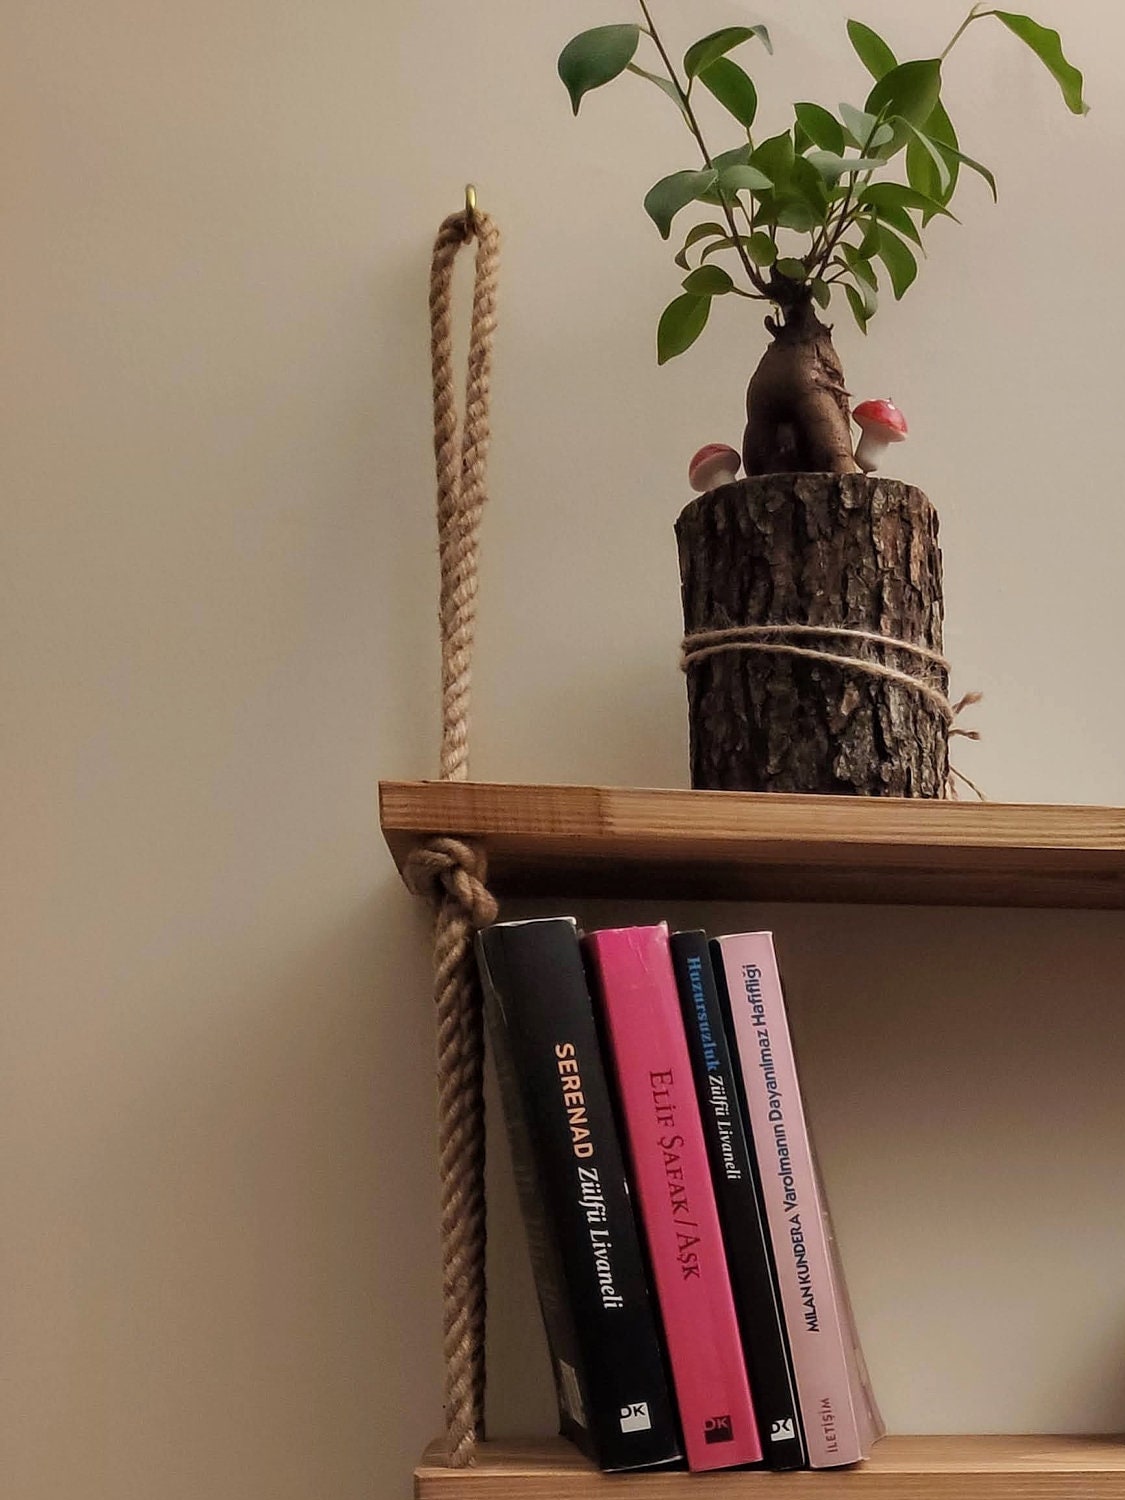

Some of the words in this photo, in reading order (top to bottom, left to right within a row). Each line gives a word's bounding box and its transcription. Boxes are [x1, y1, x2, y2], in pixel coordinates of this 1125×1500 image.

[687, 956, 720, 1071] Huzursuzluk
[742, 963, 767, 1027] Hafifliği
[554, 1042, 594, 1159] SERENAD
[650, 1068, 675, 1128] ELİF
[708, 1075, 730, 1117] Zülfü
[753, 1028, 783, 1122] Dayanılmaz
[657, 1135, 689, 1214] ŞAFAK
[718, 1119, 741, 1181] Livaneli
[769, 1123, 798, 1212] Varolmanın
[577, 1166, 607, 1223] Zülfü
[589, 1228, 623, 1310] Livaneli
[676, 1231, 701, 1280] AŞK
[789, 1214, 812, 1286] KUNDERA
[800, 1285, 821, 1333] MILAN
